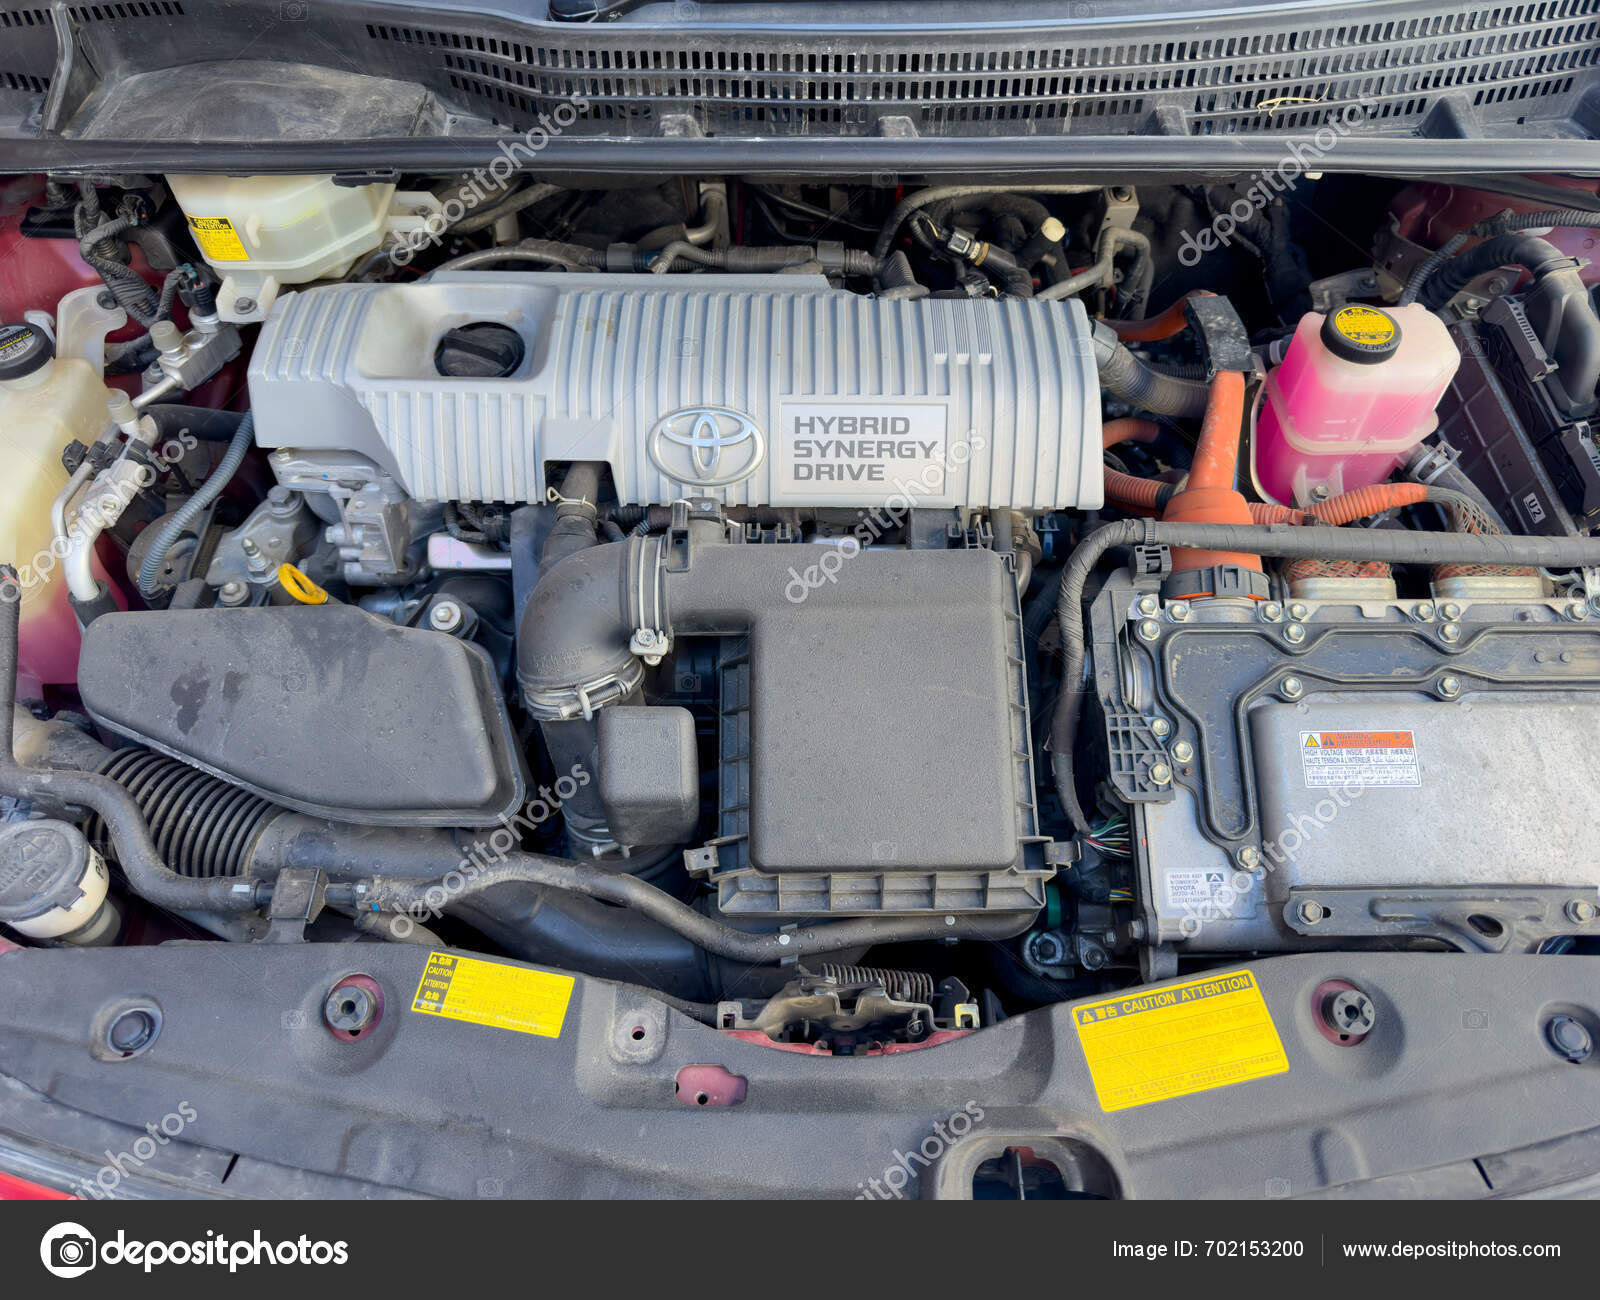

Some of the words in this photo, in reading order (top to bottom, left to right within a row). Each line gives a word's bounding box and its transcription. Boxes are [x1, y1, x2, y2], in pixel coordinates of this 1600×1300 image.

[794, 416, 910, 435] HYBRID
[793, 440, 938, 459] SYNERGY
[793, 463, 885, 481] DRIVE
[428, 966, 453, 977] CAUTION
[423, 978, 449, 990] ATTENTION
[1122, 992, 1177, 1014] CAUTION
[1181, 975, 1250, 1002] ATTENTION
